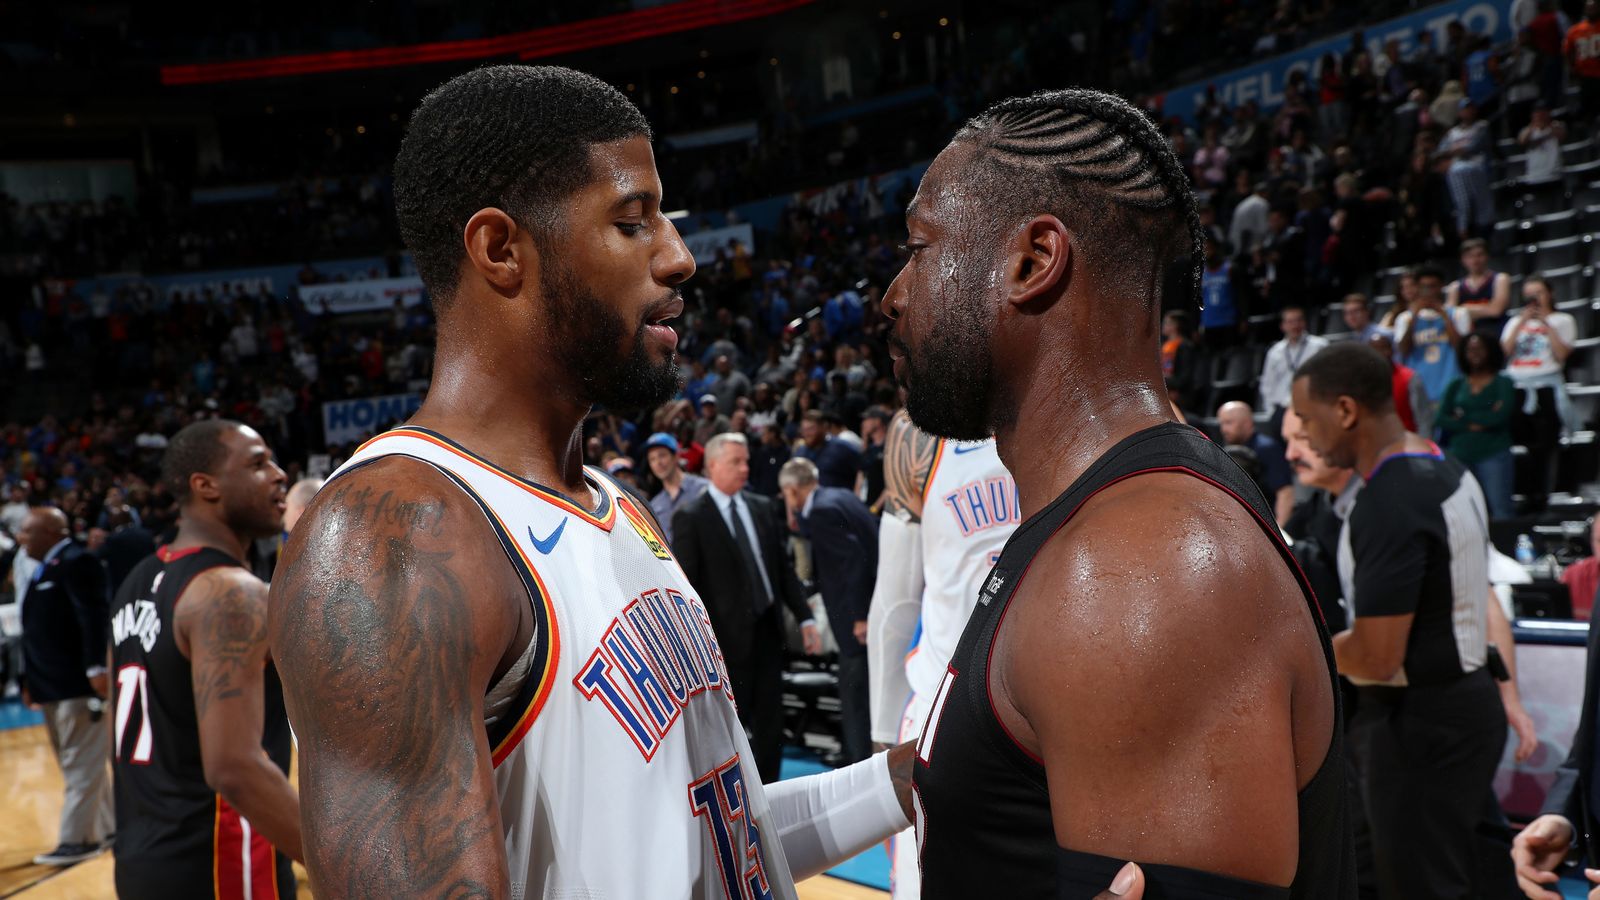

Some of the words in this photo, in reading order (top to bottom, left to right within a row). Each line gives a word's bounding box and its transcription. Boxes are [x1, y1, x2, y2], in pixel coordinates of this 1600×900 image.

[1425, 3, 1499, 56] TO
[573, 588, 738, 763] THUNDE
[687, 752, 776, 900] 13
